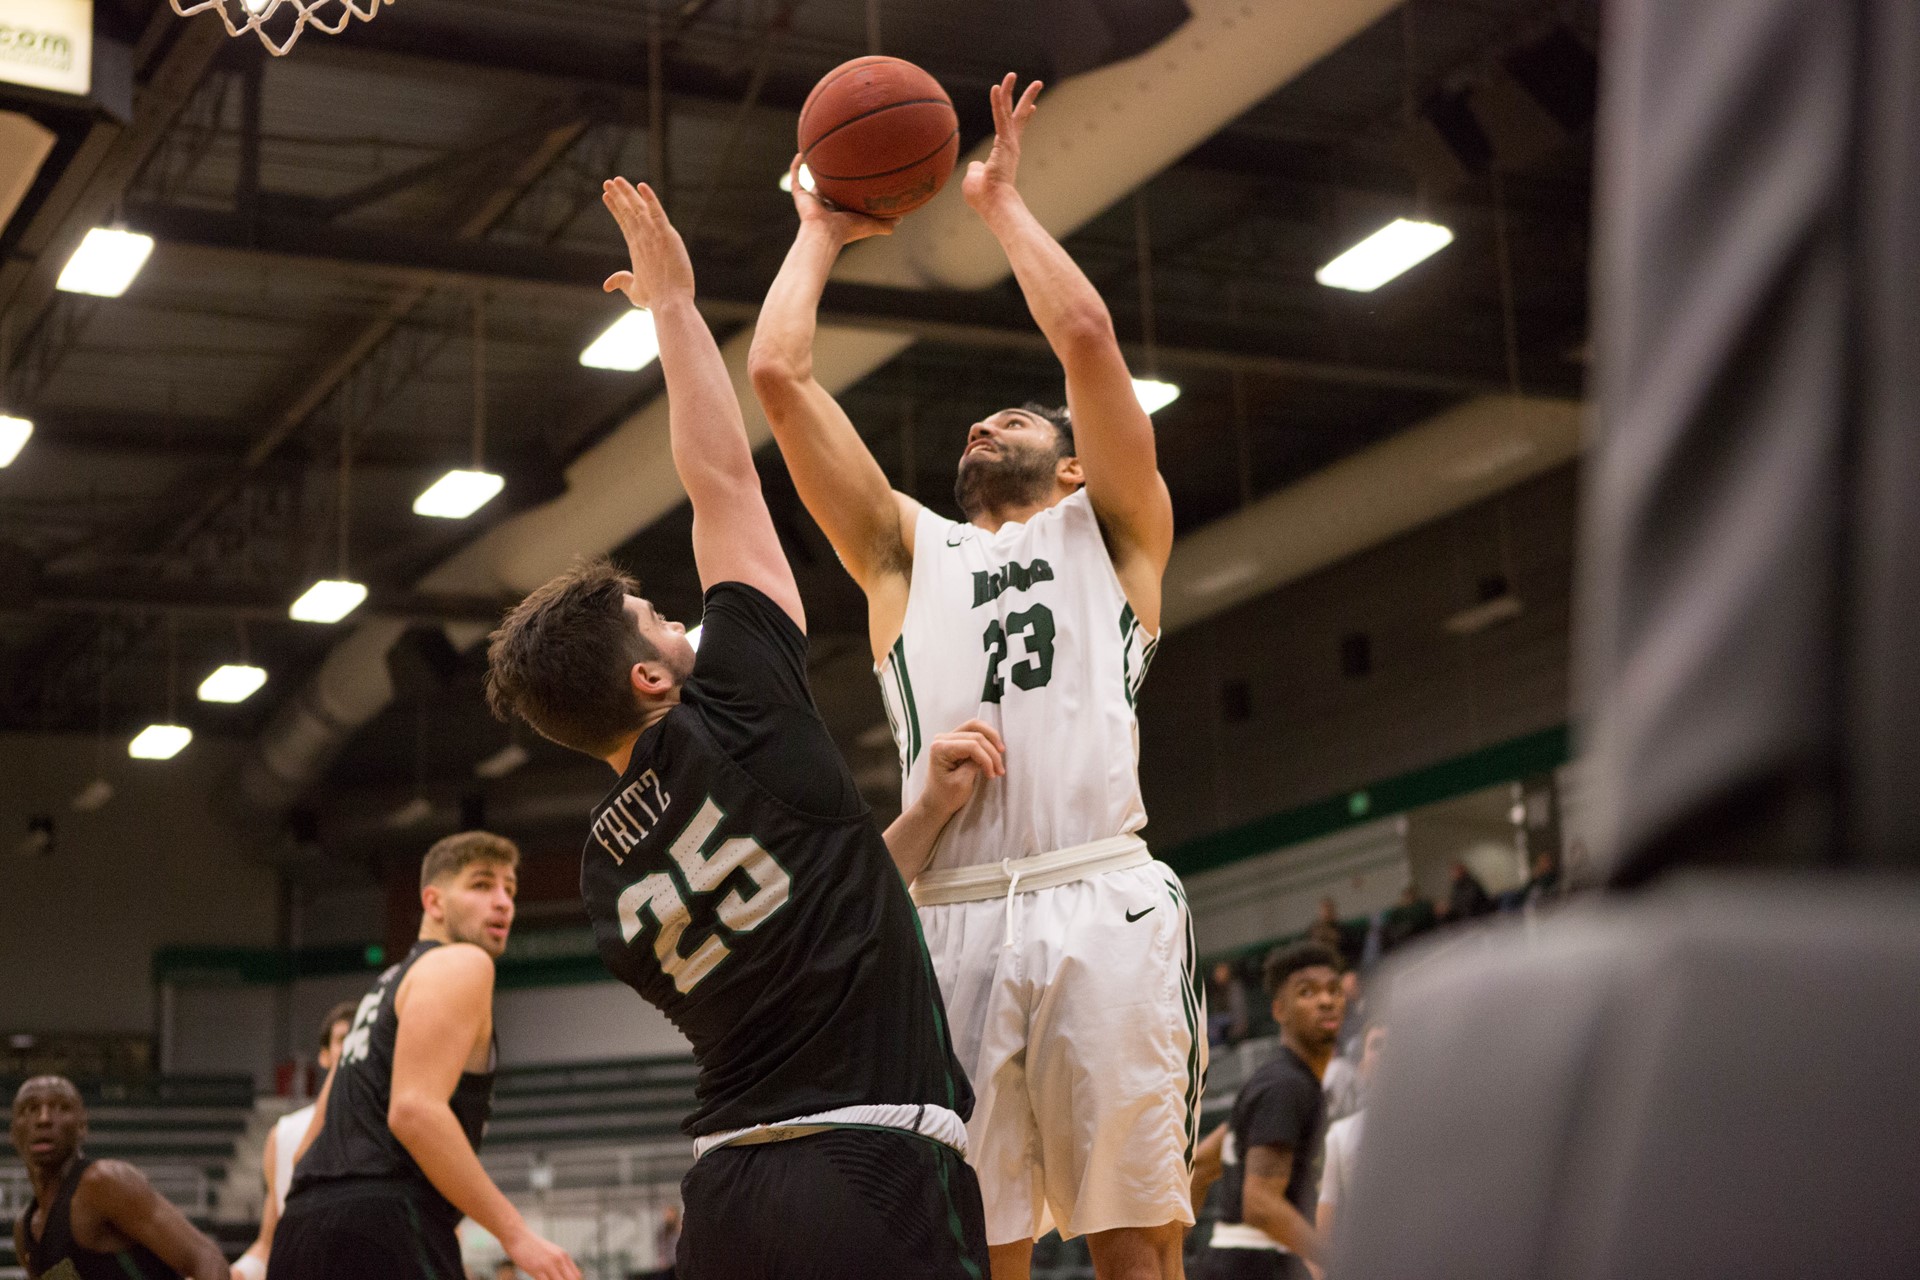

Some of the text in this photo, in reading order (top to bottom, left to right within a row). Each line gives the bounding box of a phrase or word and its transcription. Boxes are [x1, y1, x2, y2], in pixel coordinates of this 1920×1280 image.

[981, 602, 1056, 704] 23
[592, 767, 671, 866] FRITZ
[617, 794, 793, 996] 25
